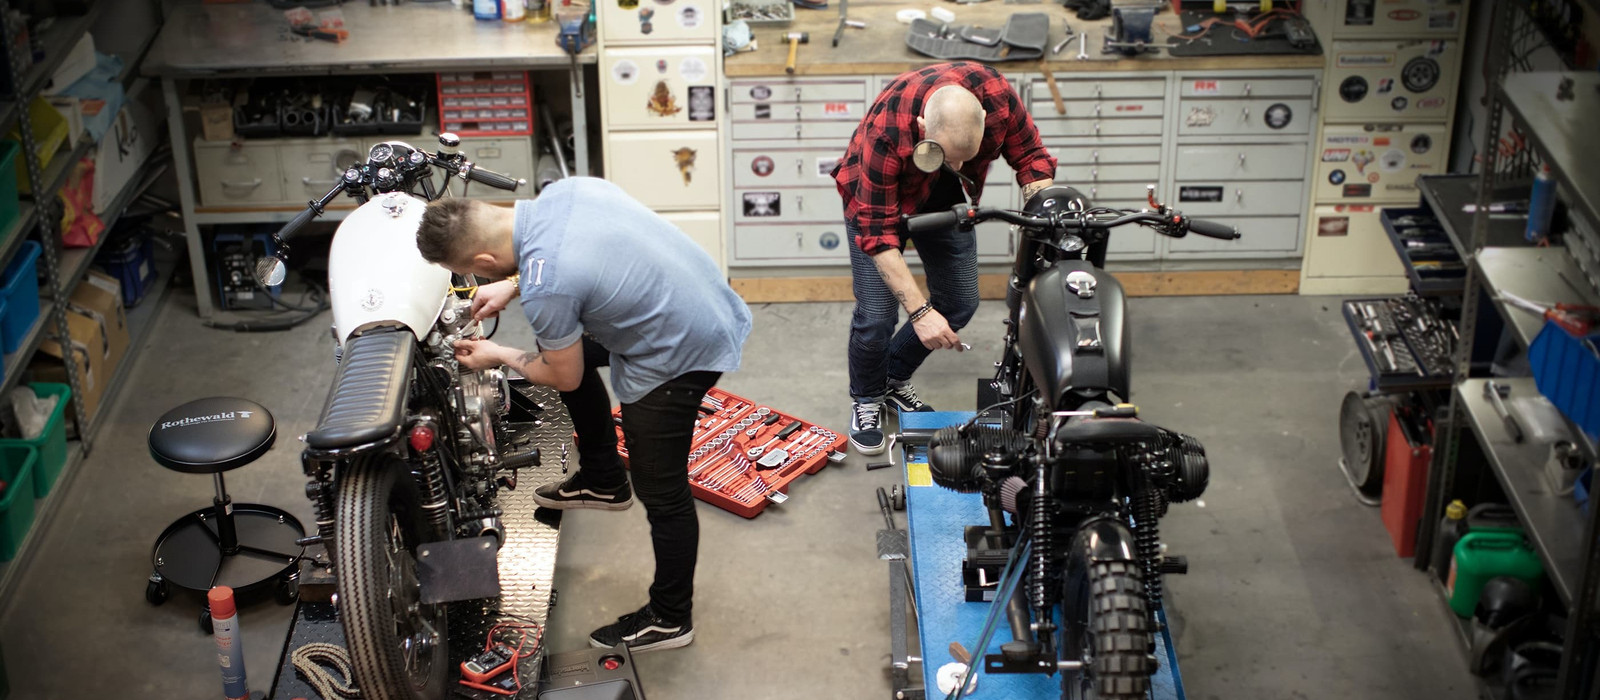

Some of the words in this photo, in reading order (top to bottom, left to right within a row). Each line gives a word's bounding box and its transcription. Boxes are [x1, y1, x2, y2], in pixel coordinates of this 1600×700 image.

[1194, 81, 1216, 90] RK
[825, 103, 847, 112] RK
[161, 411, 235, 429] Rothewald
